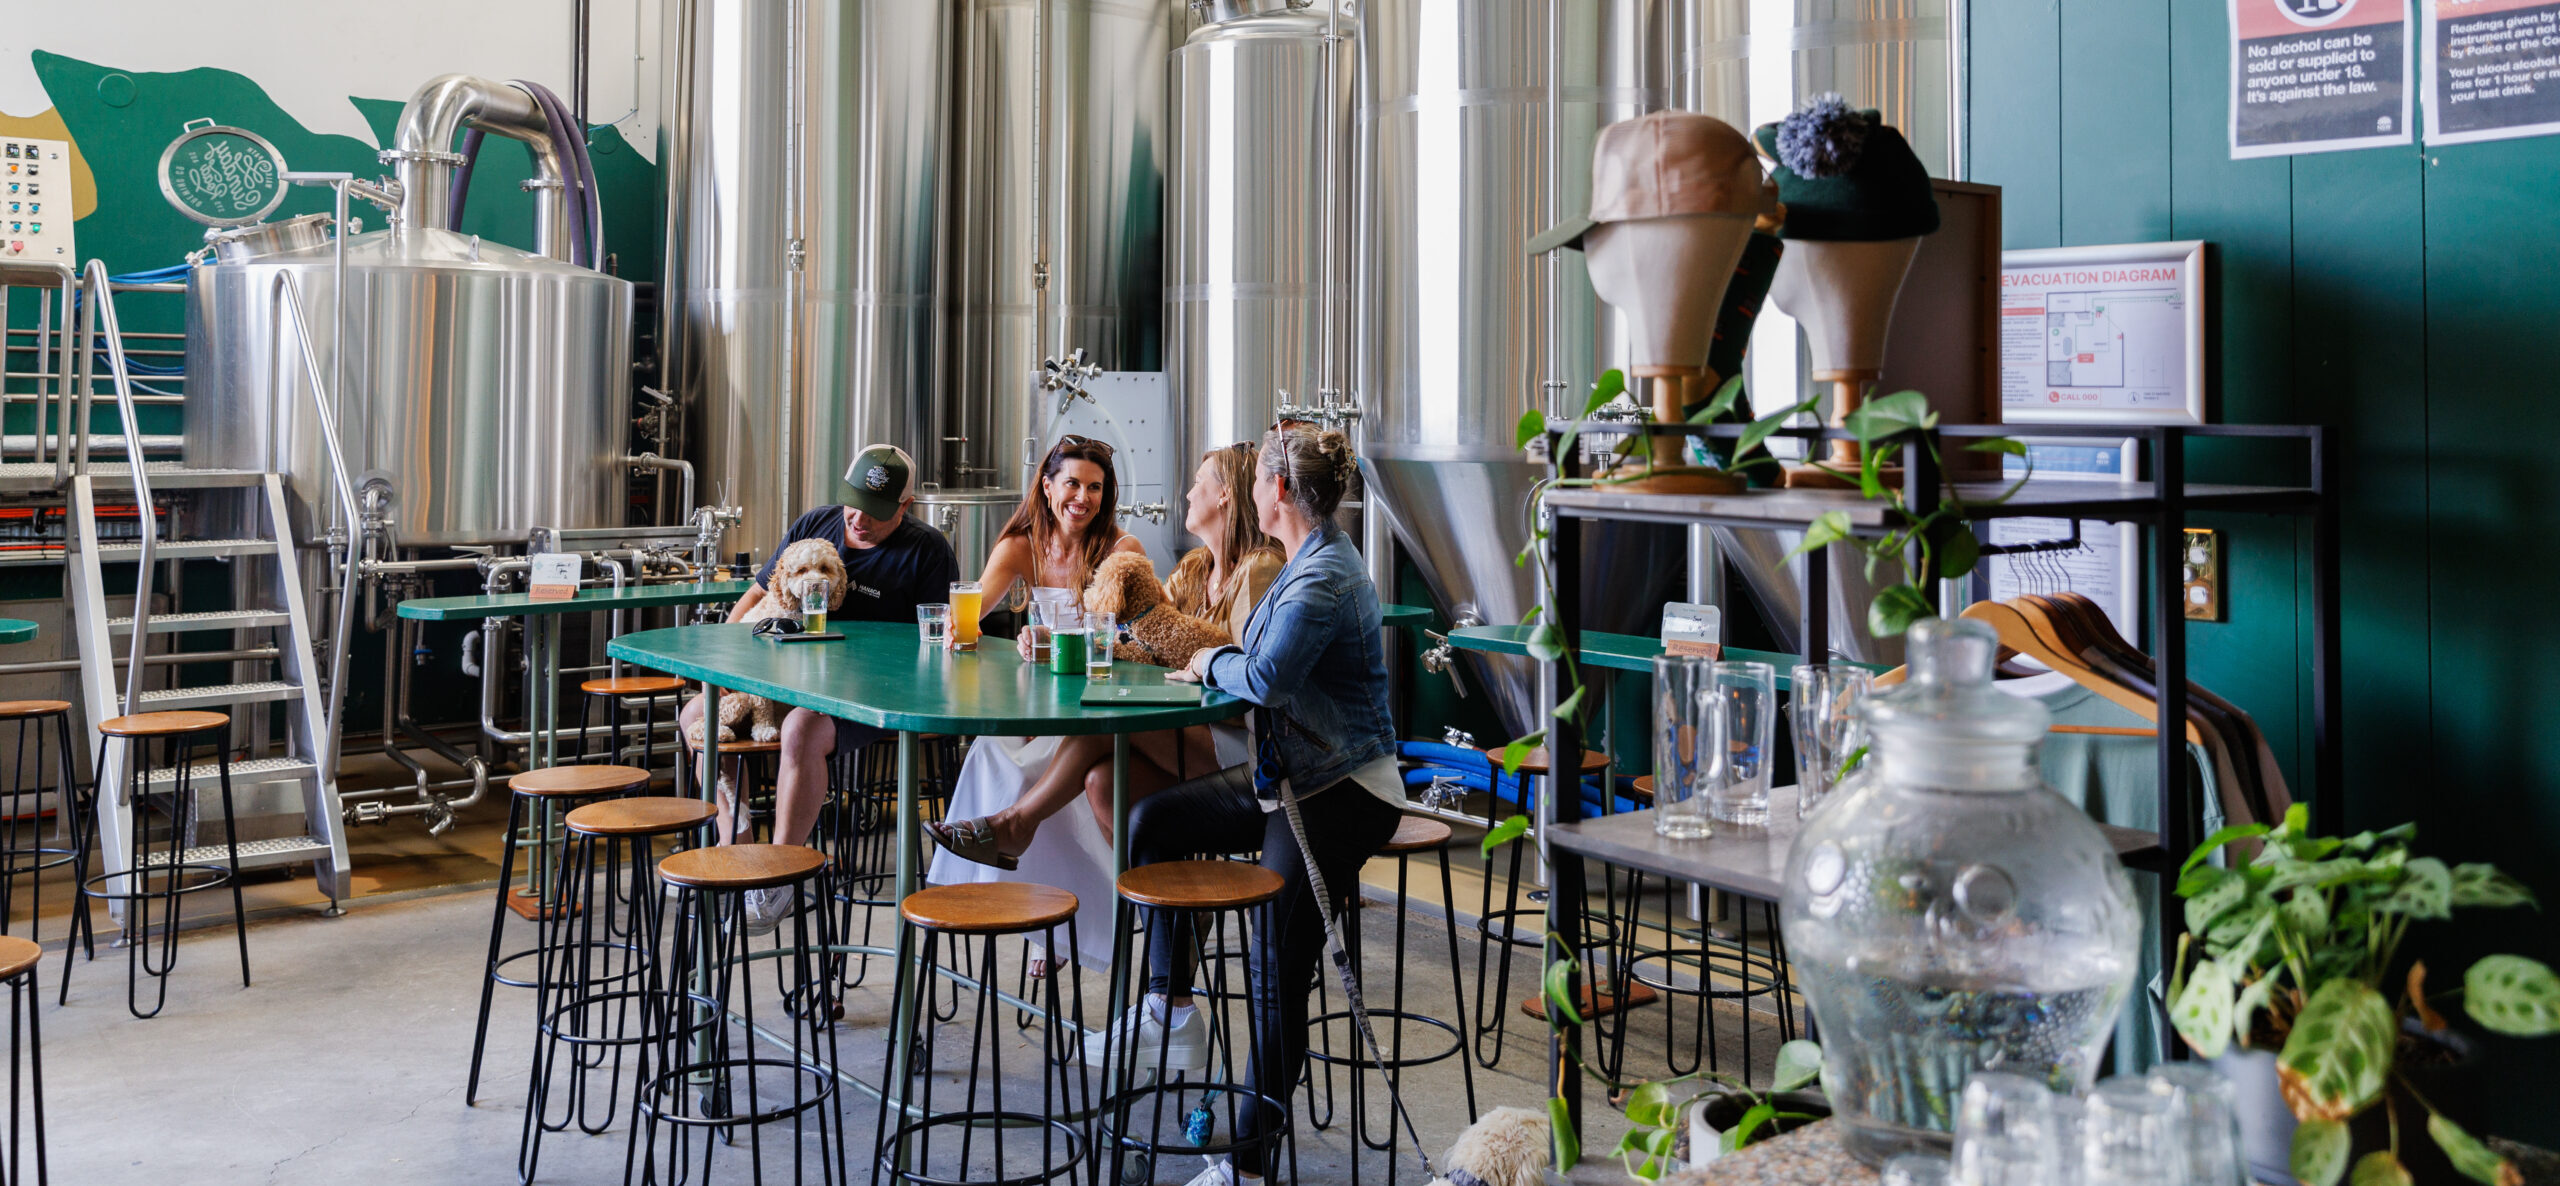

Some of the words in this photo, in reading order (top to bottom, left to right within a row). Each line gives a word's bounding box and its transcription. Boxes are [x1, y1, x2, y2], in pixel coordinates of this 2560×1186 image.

[2450, 20, 2504, 35] Readings
[2506, 14, 2538, 29] given
[2540, 12, 2556, 23] by
[2450, 30, 2512, 47] instrument
[2514, 27, 2534, 39] are
[2536, 23, 2556, 35] not
[2248, 45, 2268, 58] No
[2270, 38, 2321, 55] alcohol
[2323, 37, 2350, 50] can
[2353, 33, 2373, 47] be
[2450, 48, 2465, 59] by
[2467, 44, 2503, 56] Police
[2505, 42, 2518, 51] or
[2520, 39, 2540, 50] the
[2247, 59, 2277, 73] sold
[2279, 59, 2295, 70] or
[2297, 50, 2357, 69] supplied
[2360, 49, 2376, 61] to
[2449, 67, 2475, 78] Your
[2477, 62, 2510, 75] blood
[2512, 55, 2556, 71] alcohol
[2247, 73, 2297, 89] anyone
[2300, 69, 2341, 83] under
[2344, 65, 2365, 79] 18.
[2450, 79, 2473, 90] rise
[2474, 76, 2491, 87] for
[2494, 74, 2500, 85] 1
[2503, 72, 2530, 83] hour
[2532, 71, 2546, 80] or
[2247, 90, 2266, 104] It's
[2269, 85, 2320, 103] against
[2322, 82, 2346, 97] the
[2349, 80, 2378, 94] law.
[2450, 92, 2476, 104] your
[2478, 86, 2500, 99] last
[2501, 83, 2536, 96] drink.
[2001, 271, 2099, 287] EVACUATION
[2102, 267, 2177, 284] DIAGRAM
[2060, 393, 2081, 401] CALL
[2082, 393, 2098, 401] 000
